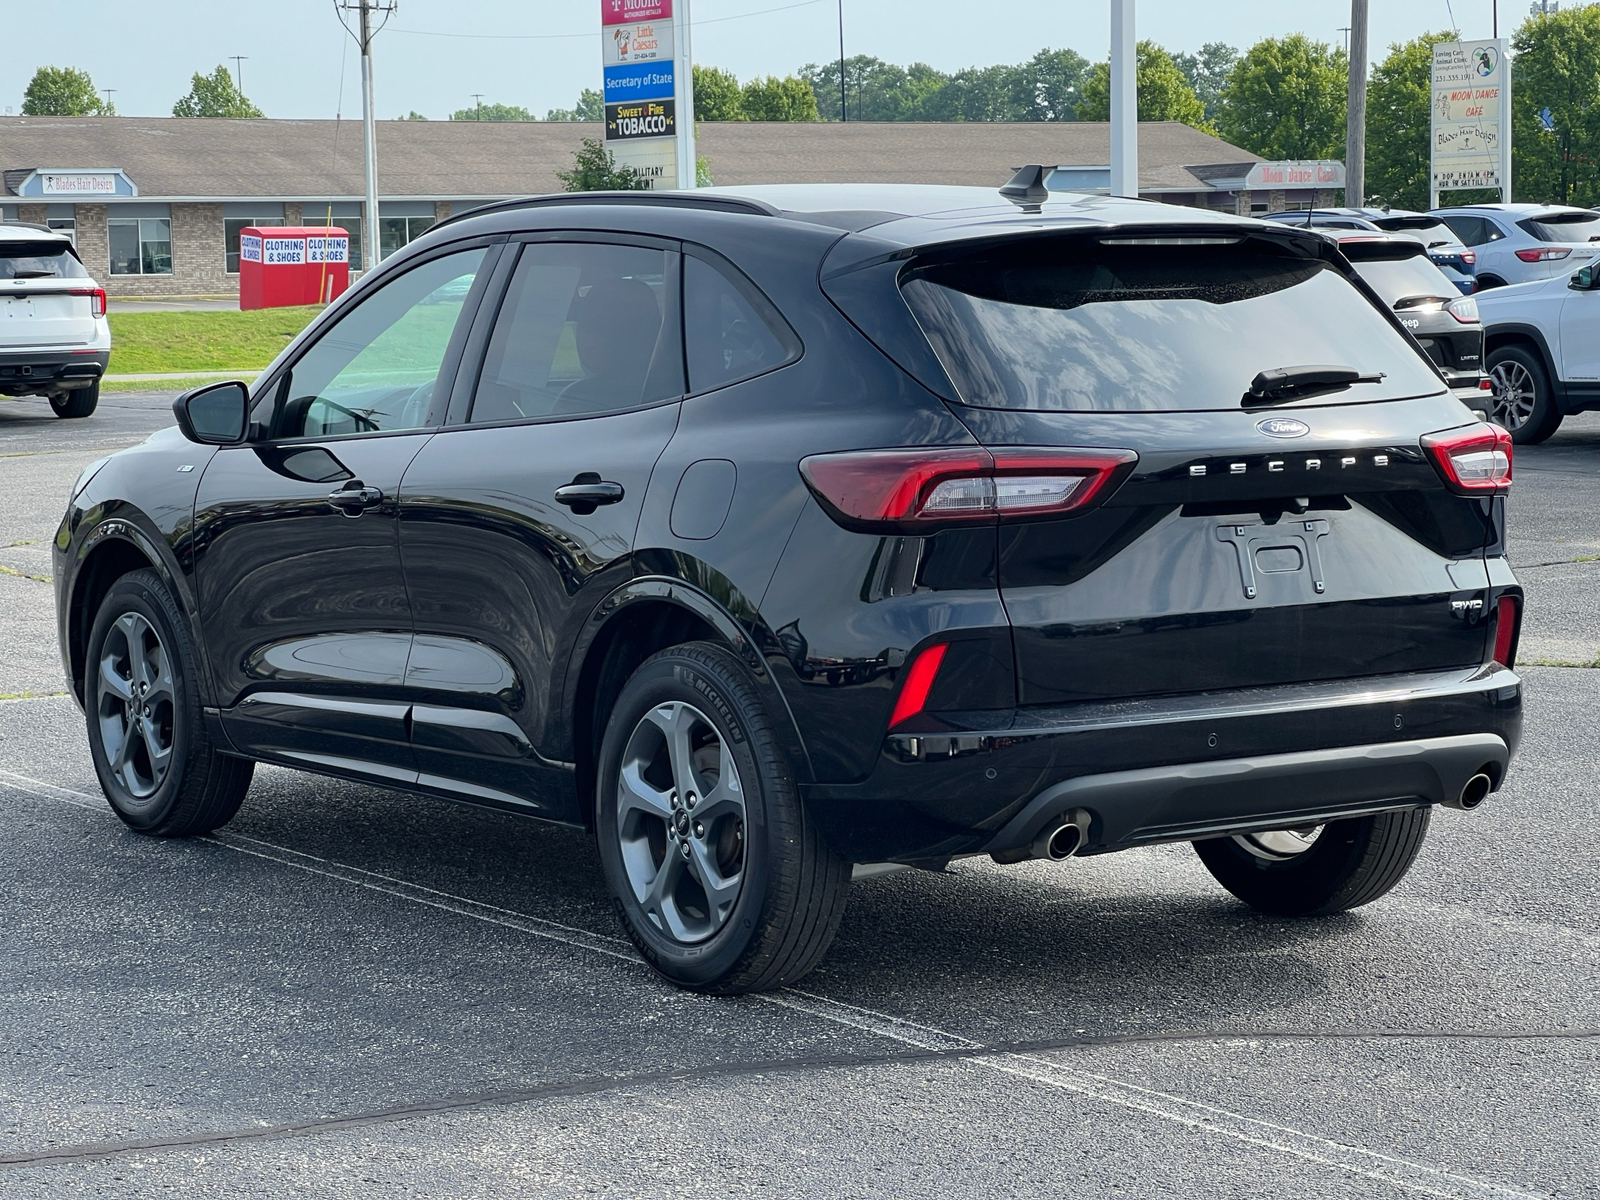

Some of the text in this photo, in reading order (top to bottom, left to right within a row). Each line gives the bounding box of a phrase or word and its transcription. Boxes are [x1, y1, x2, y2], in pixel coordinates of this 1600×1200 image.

[637, 26, 653, 37] Little
[632, 39, 658, 50] Caesars
[607, 74, 672, 88] Secretary of State
[1451, 89, 1498, 101] MOON DANCE
[617, 115, 666, 135] TOBACCO
[1475, 129, 1496, 143] Design
[1262, 168, 1282, 182] Moon
[1288, 167, 1311, 182] Dance
[56, 177, 112, 193] Blades Hair Design
[242, 237, 260, 248] CLOTHING
[265, 241, 304, 250] CLOTHING
[308, 239, 346, 249] CLOTHING
[247, 250, 260, 260] SHOES
[269, 252, 300, 262] & SHOES
[312, 251, 343, 260] & SHOES
[1271, 421, 1303, 432] Ford
[1190, 455, 1388, 476] ESCAPE
[1452, 599, 1483, 610] AWD
[695, 679, 742, 740] MICHELIN
